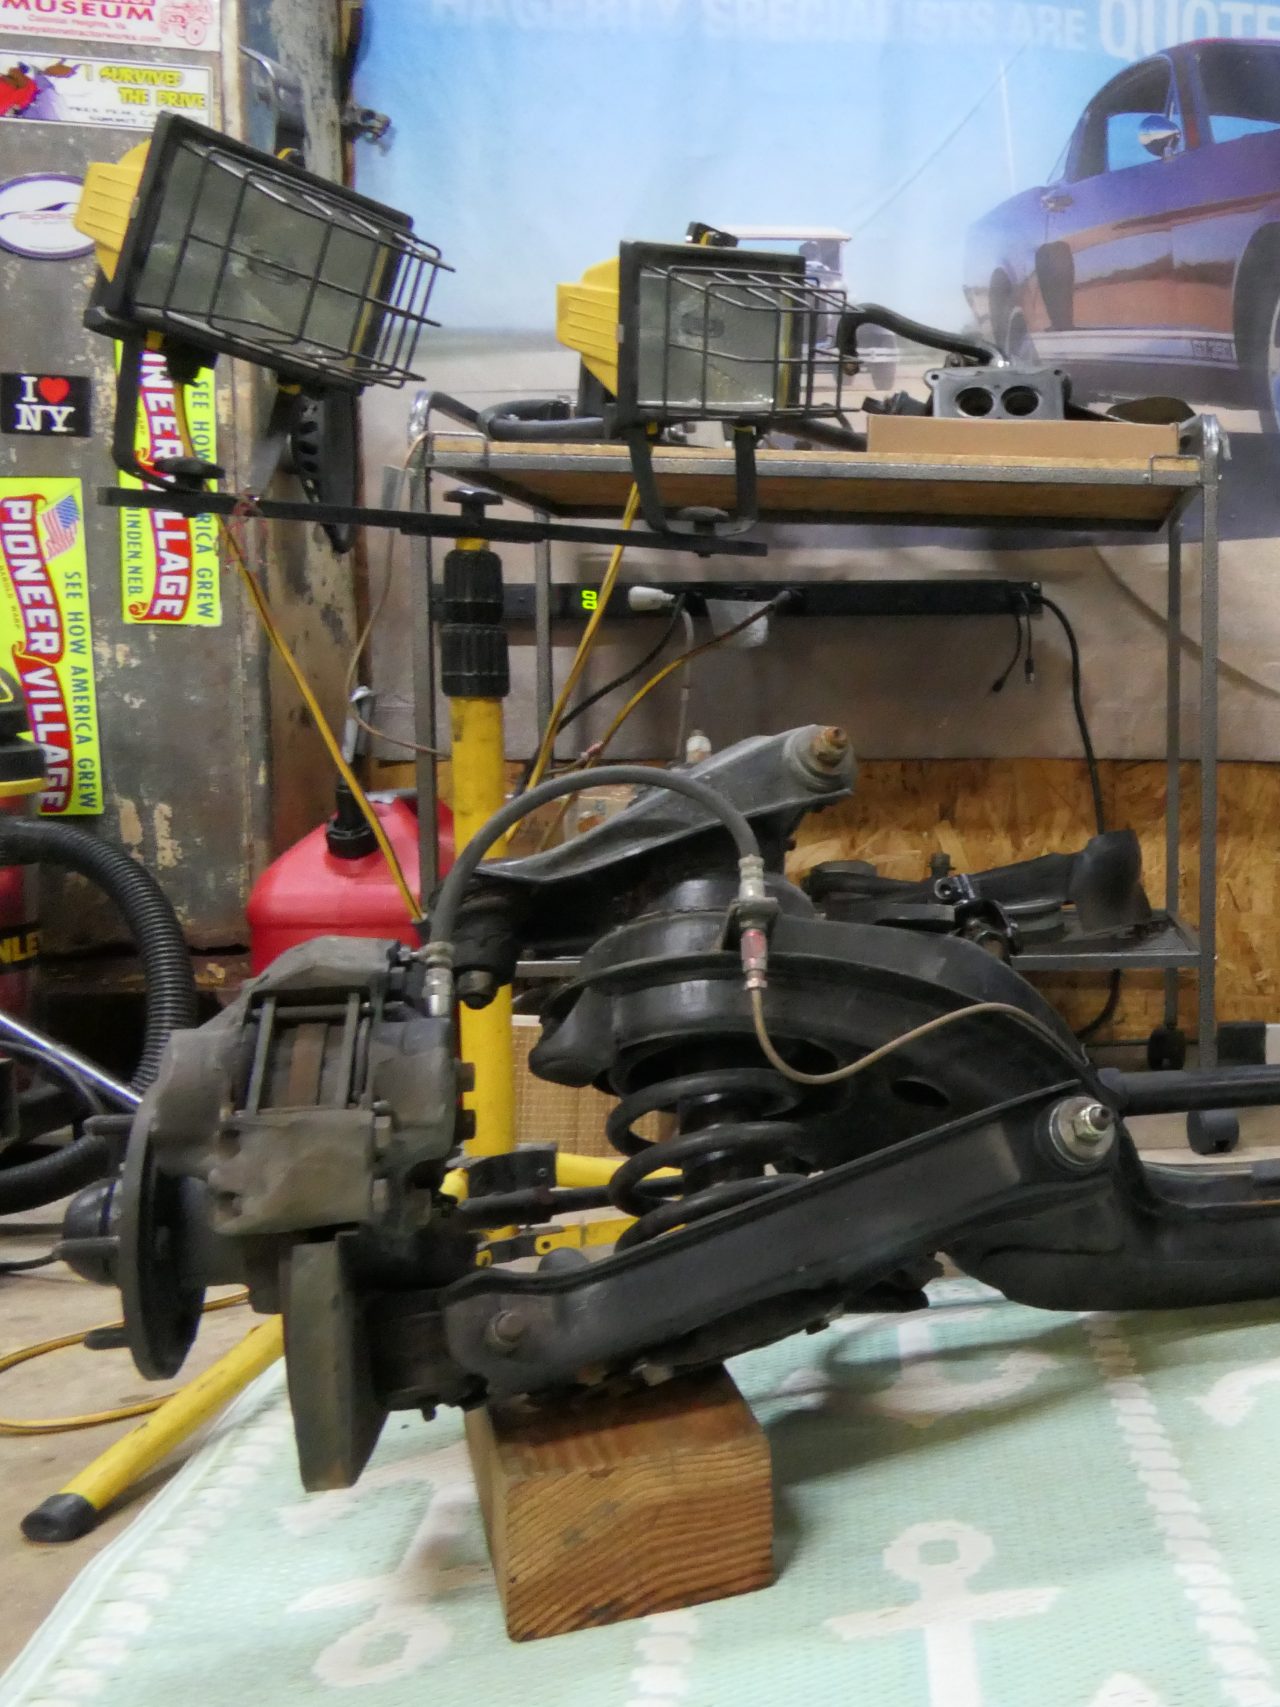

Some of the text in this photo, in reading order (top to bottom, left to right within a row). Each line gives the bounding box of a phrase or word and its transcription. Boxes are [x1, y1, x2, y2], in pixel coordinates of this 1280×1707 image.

[2, 0, 154, 21] MUSEUM
[1006, 4, 1087, 51] ARE
[118, 87, 149, 105] THE
[22, 375, 37, 403] I
[16, 404, 76, 432] NY
[2, 500, 60, 654] PIONEER
[196, 567, 214, 619] GREW
[64, 571, 97, 809] SEE HOW AMERICA GREW
